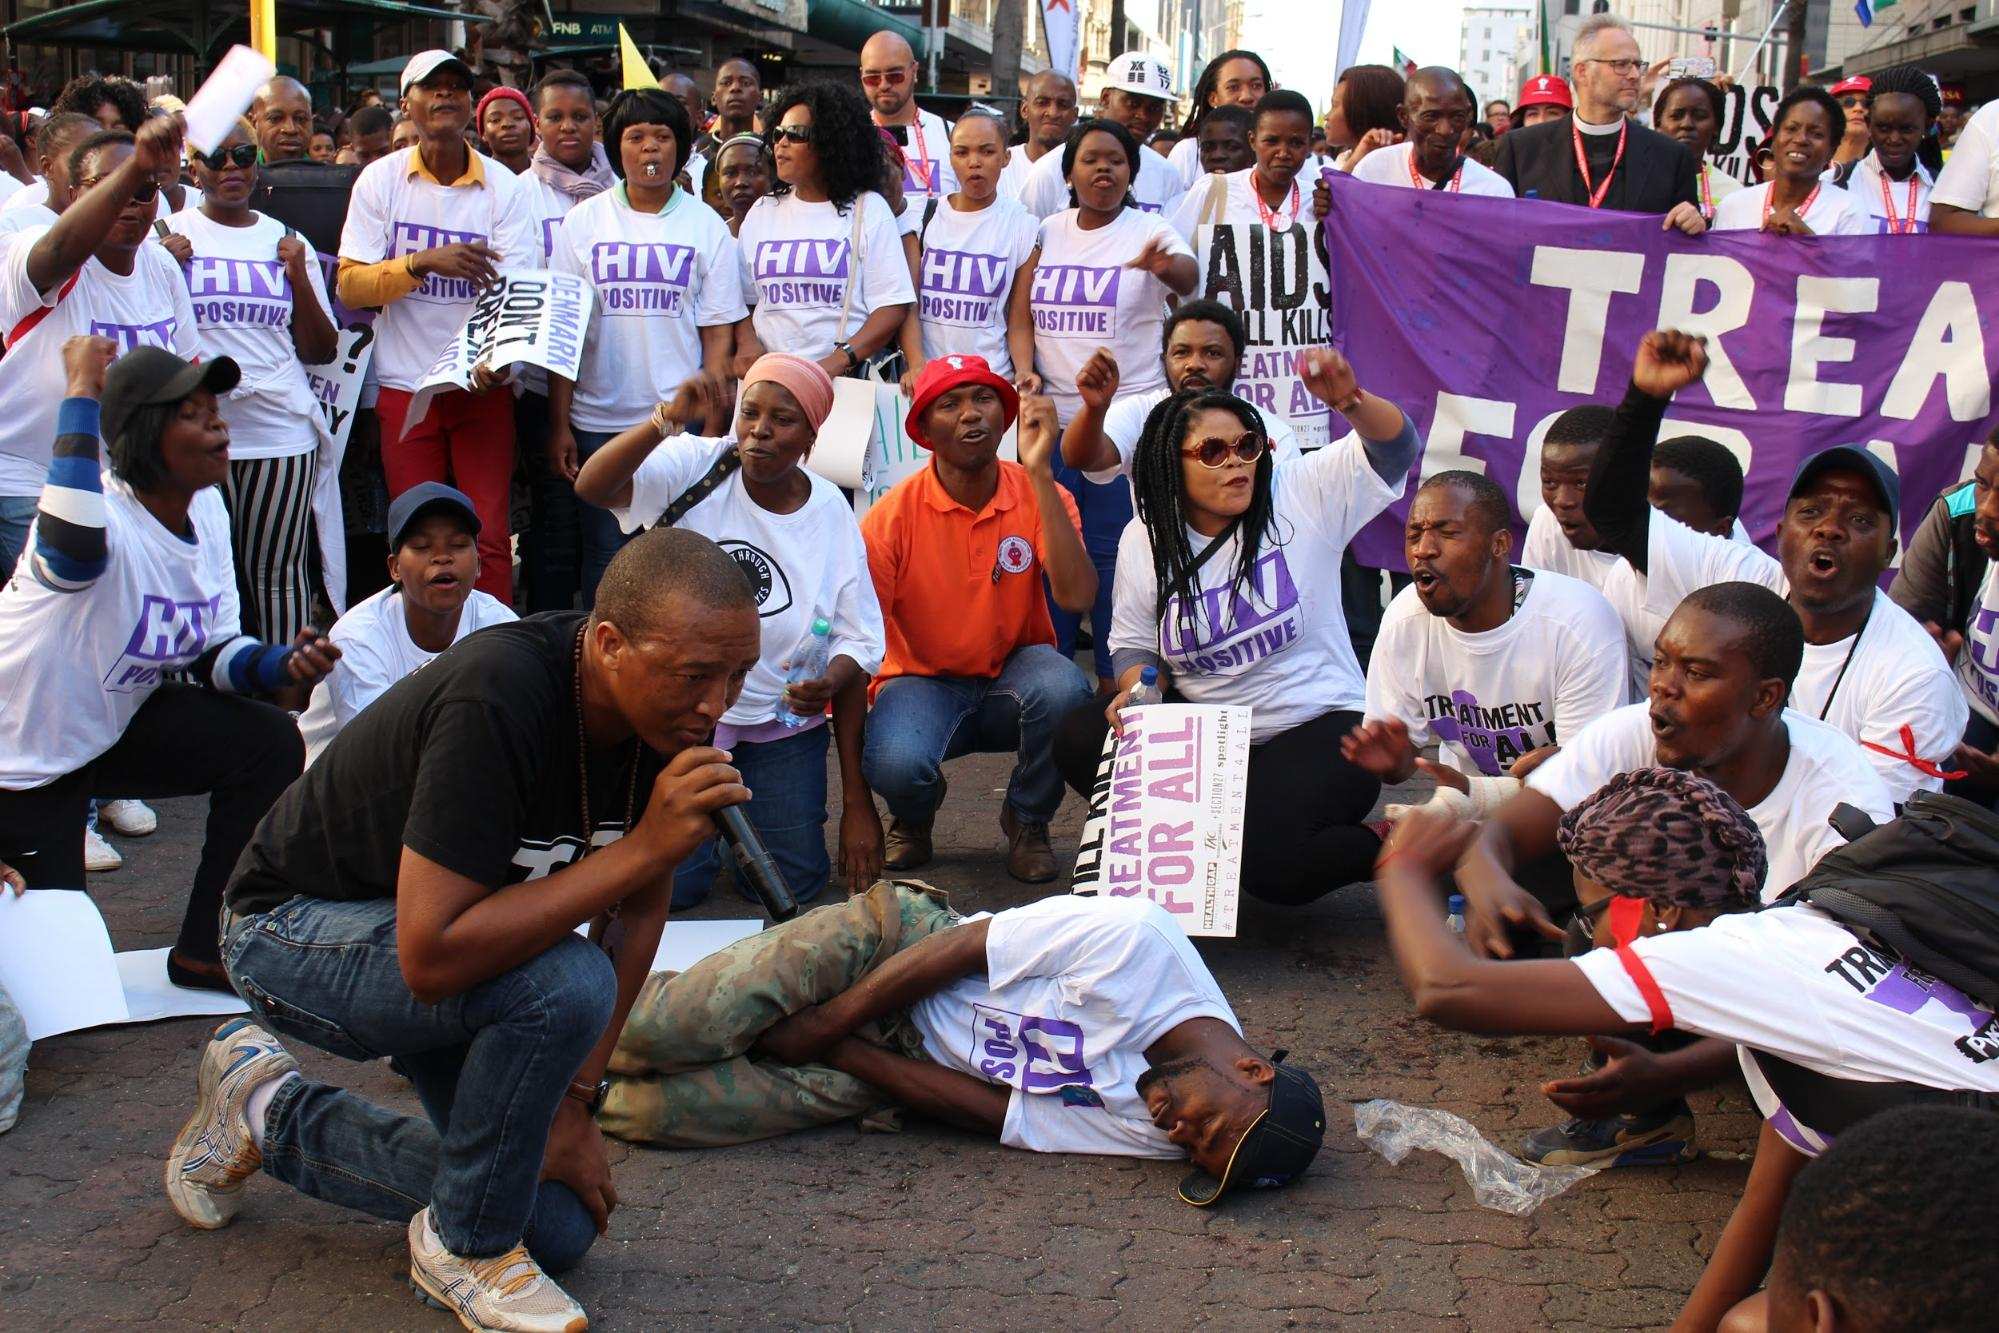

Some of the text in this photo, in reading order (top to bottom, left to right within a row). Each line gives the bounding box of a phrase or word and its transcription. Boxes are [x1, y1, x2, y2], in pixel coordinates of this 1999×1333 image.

[553, 22, 614, 35] FNB ATM
[598, 244, 689, 282] HIV
[758, 240, 847, 275] HIV
[923, 252, 1008, 294] HIV
[191, 259, 288, 297] HIV
[411, 276, 478, 297] SITIVE
[762, 282, 842, 305] POSITIVE
[1032, 268, 1115, 303] HIV
[195, 301, 288, 326] POSITIVE
[496, 280, 547, 347] DON'T
[603, 287, 681, 311] POSITIVE
[922, 296, 992, 322] POSITIV
[546, 275, 581, 373] DENMARK
[1032, 310, 1107, 332] POSITIVE
[1233, 382, 1277, 415] OR
[729, 550, 770, 580] THROUGH
[1178, 616, 1298, 672] POSITIVE
[1424, 694, 1544, 731] TRATMENT
[1217, 710, 1229, 768] spotlight
[1462, 731, 1491, 748] FOR
[1109, 711, 1143, 897] REATMENT
[1147, 716, 1195, 914] FOR ALL
[1203, 886, 1216, 929] HEALTH
